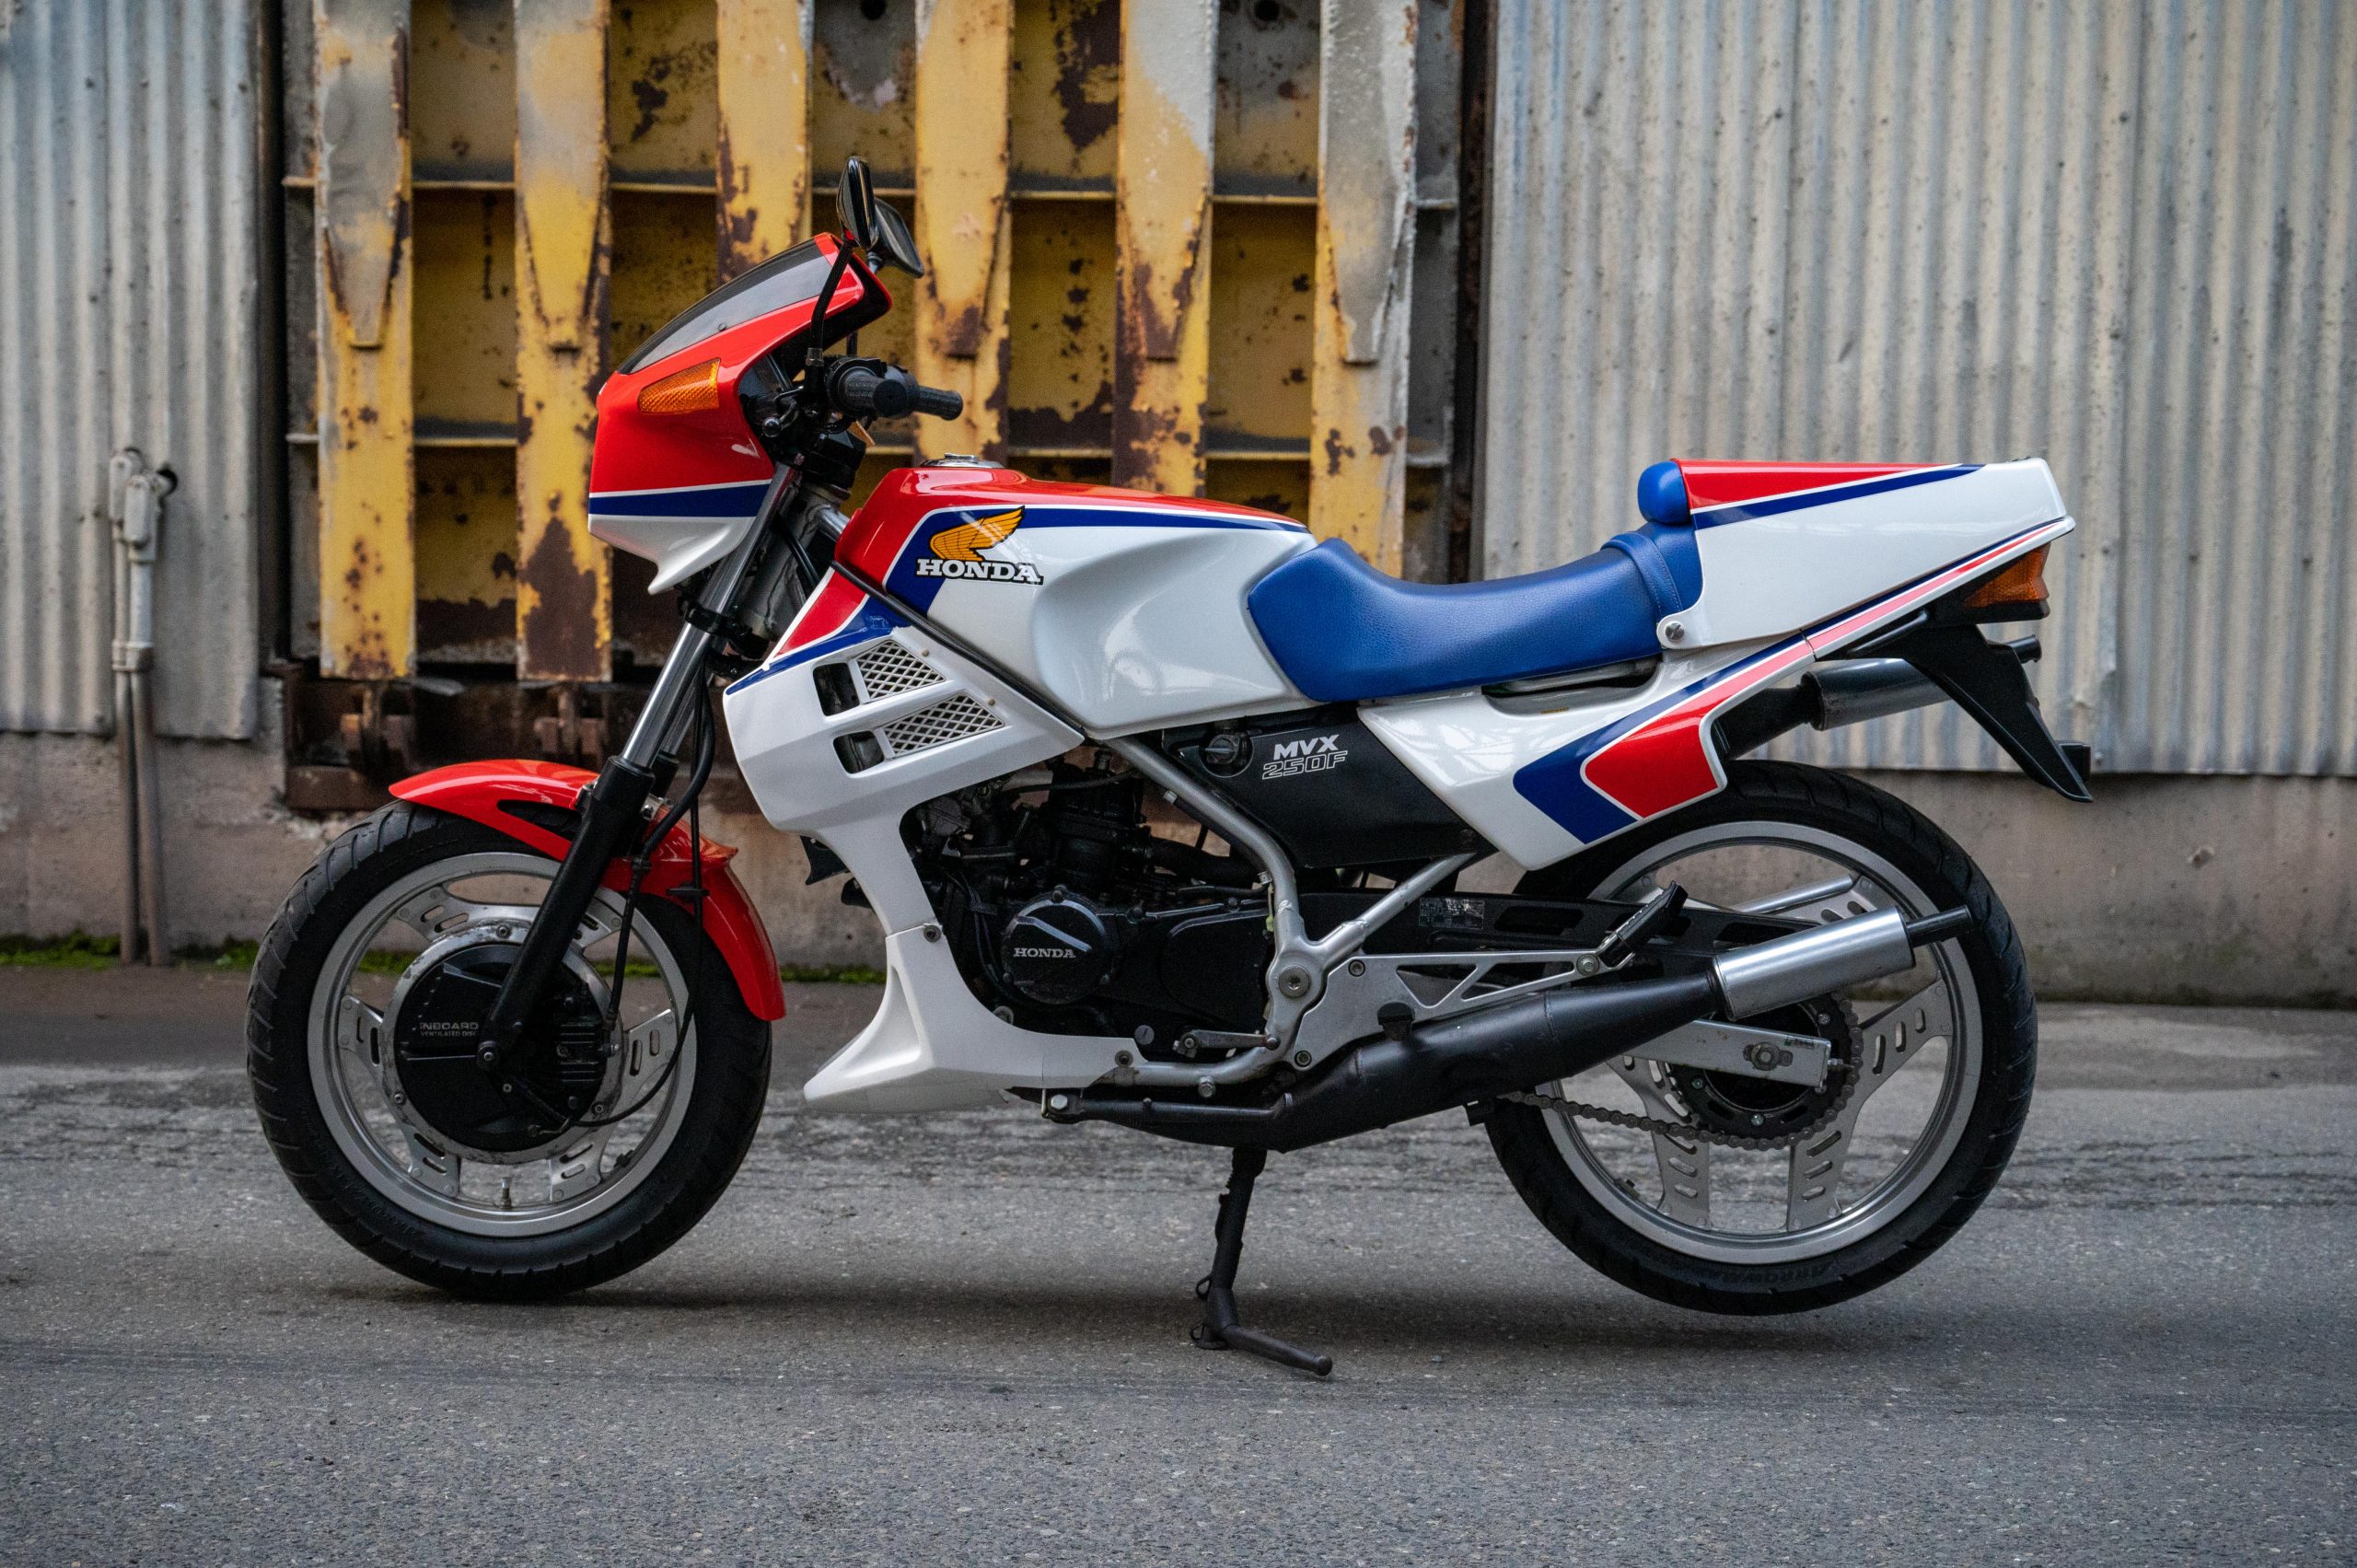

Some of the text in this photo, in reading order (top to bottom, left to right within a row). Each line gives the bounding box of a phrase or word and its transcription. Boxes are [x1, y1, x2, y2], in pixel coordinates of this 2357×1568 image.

[916, 558, 1044, 585] HONDA
[1273, 734, 1340, 761] MVX
[1261, 750, 1349, 781] 250F
[1013, 947, 1076, 958] HONDA
